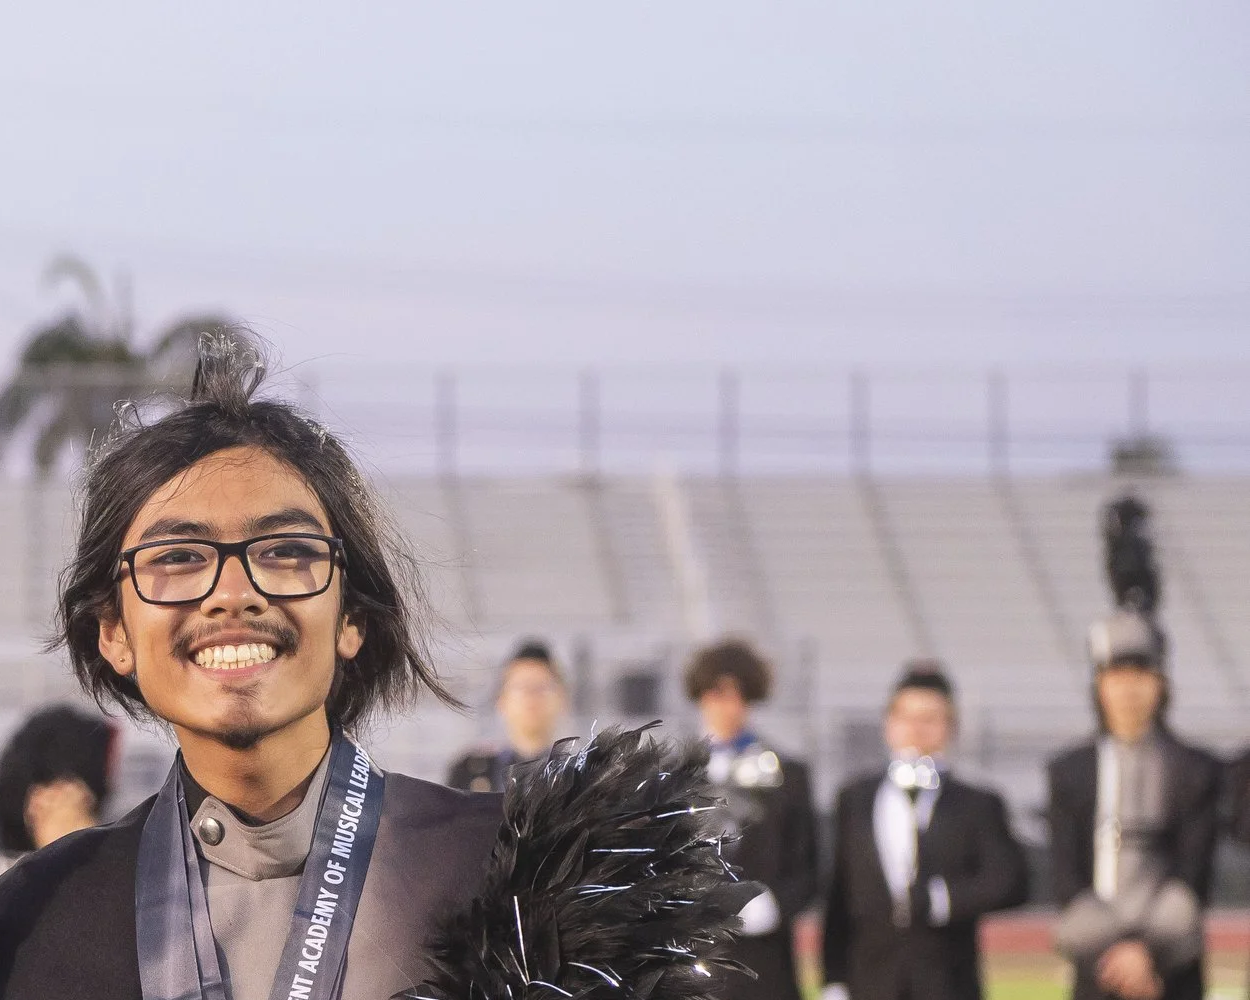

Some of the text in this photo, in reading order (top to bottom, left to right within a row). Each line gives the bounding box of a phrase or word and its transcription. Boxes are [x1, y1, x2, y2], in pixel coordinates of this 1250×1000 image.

[331, 790, 366, 859] MUSICAL
[324, 860, 347, 885] OF
[298, 887, 339, 974] ACADEMY
